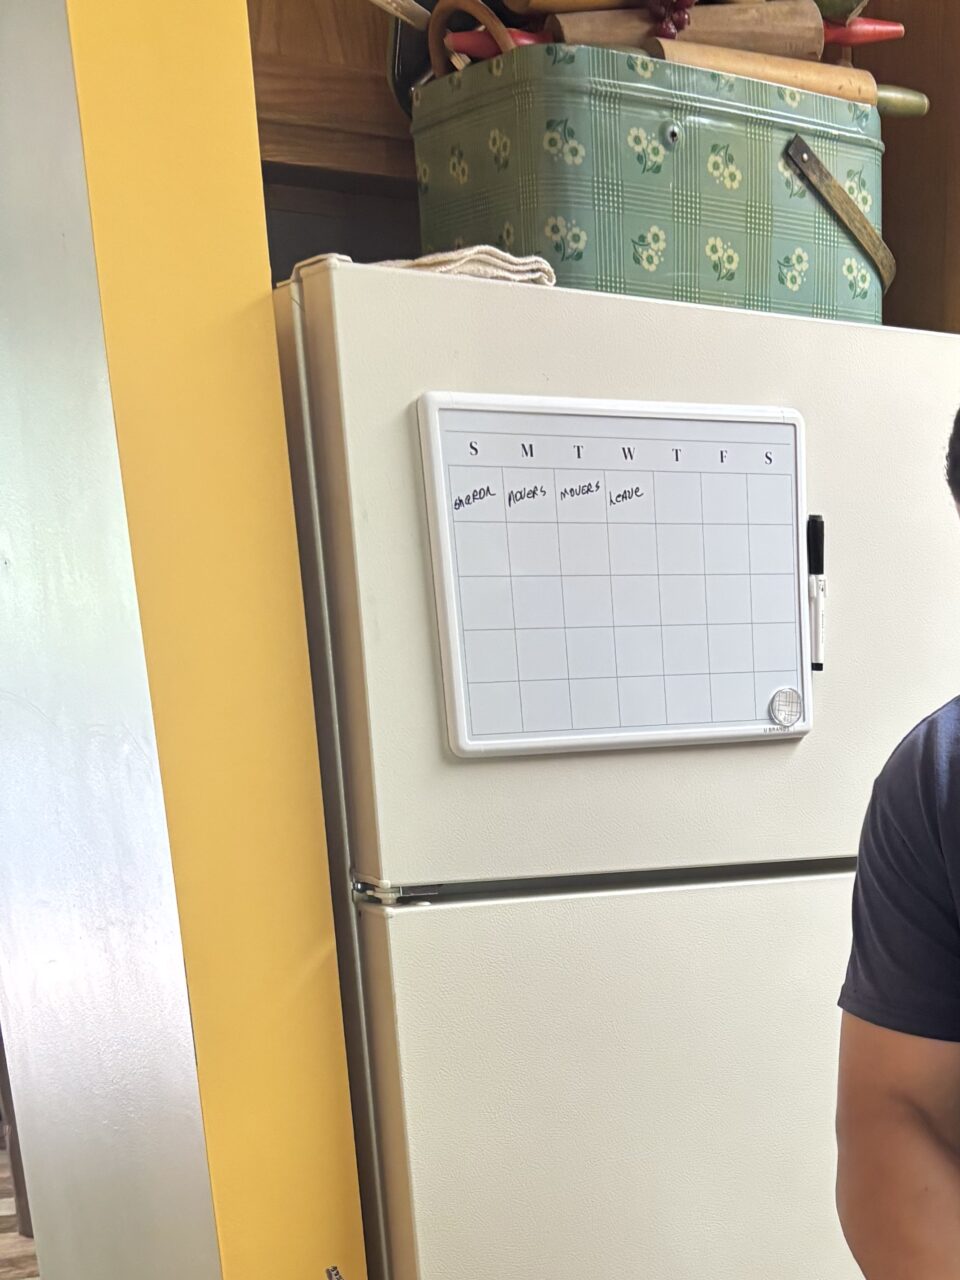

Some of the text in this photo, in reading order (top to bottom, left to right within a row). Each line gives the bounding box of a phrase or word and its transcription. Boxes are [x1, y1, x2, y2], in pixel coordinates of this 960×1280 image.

[469, 441, 773, 465] S M T W T F S
